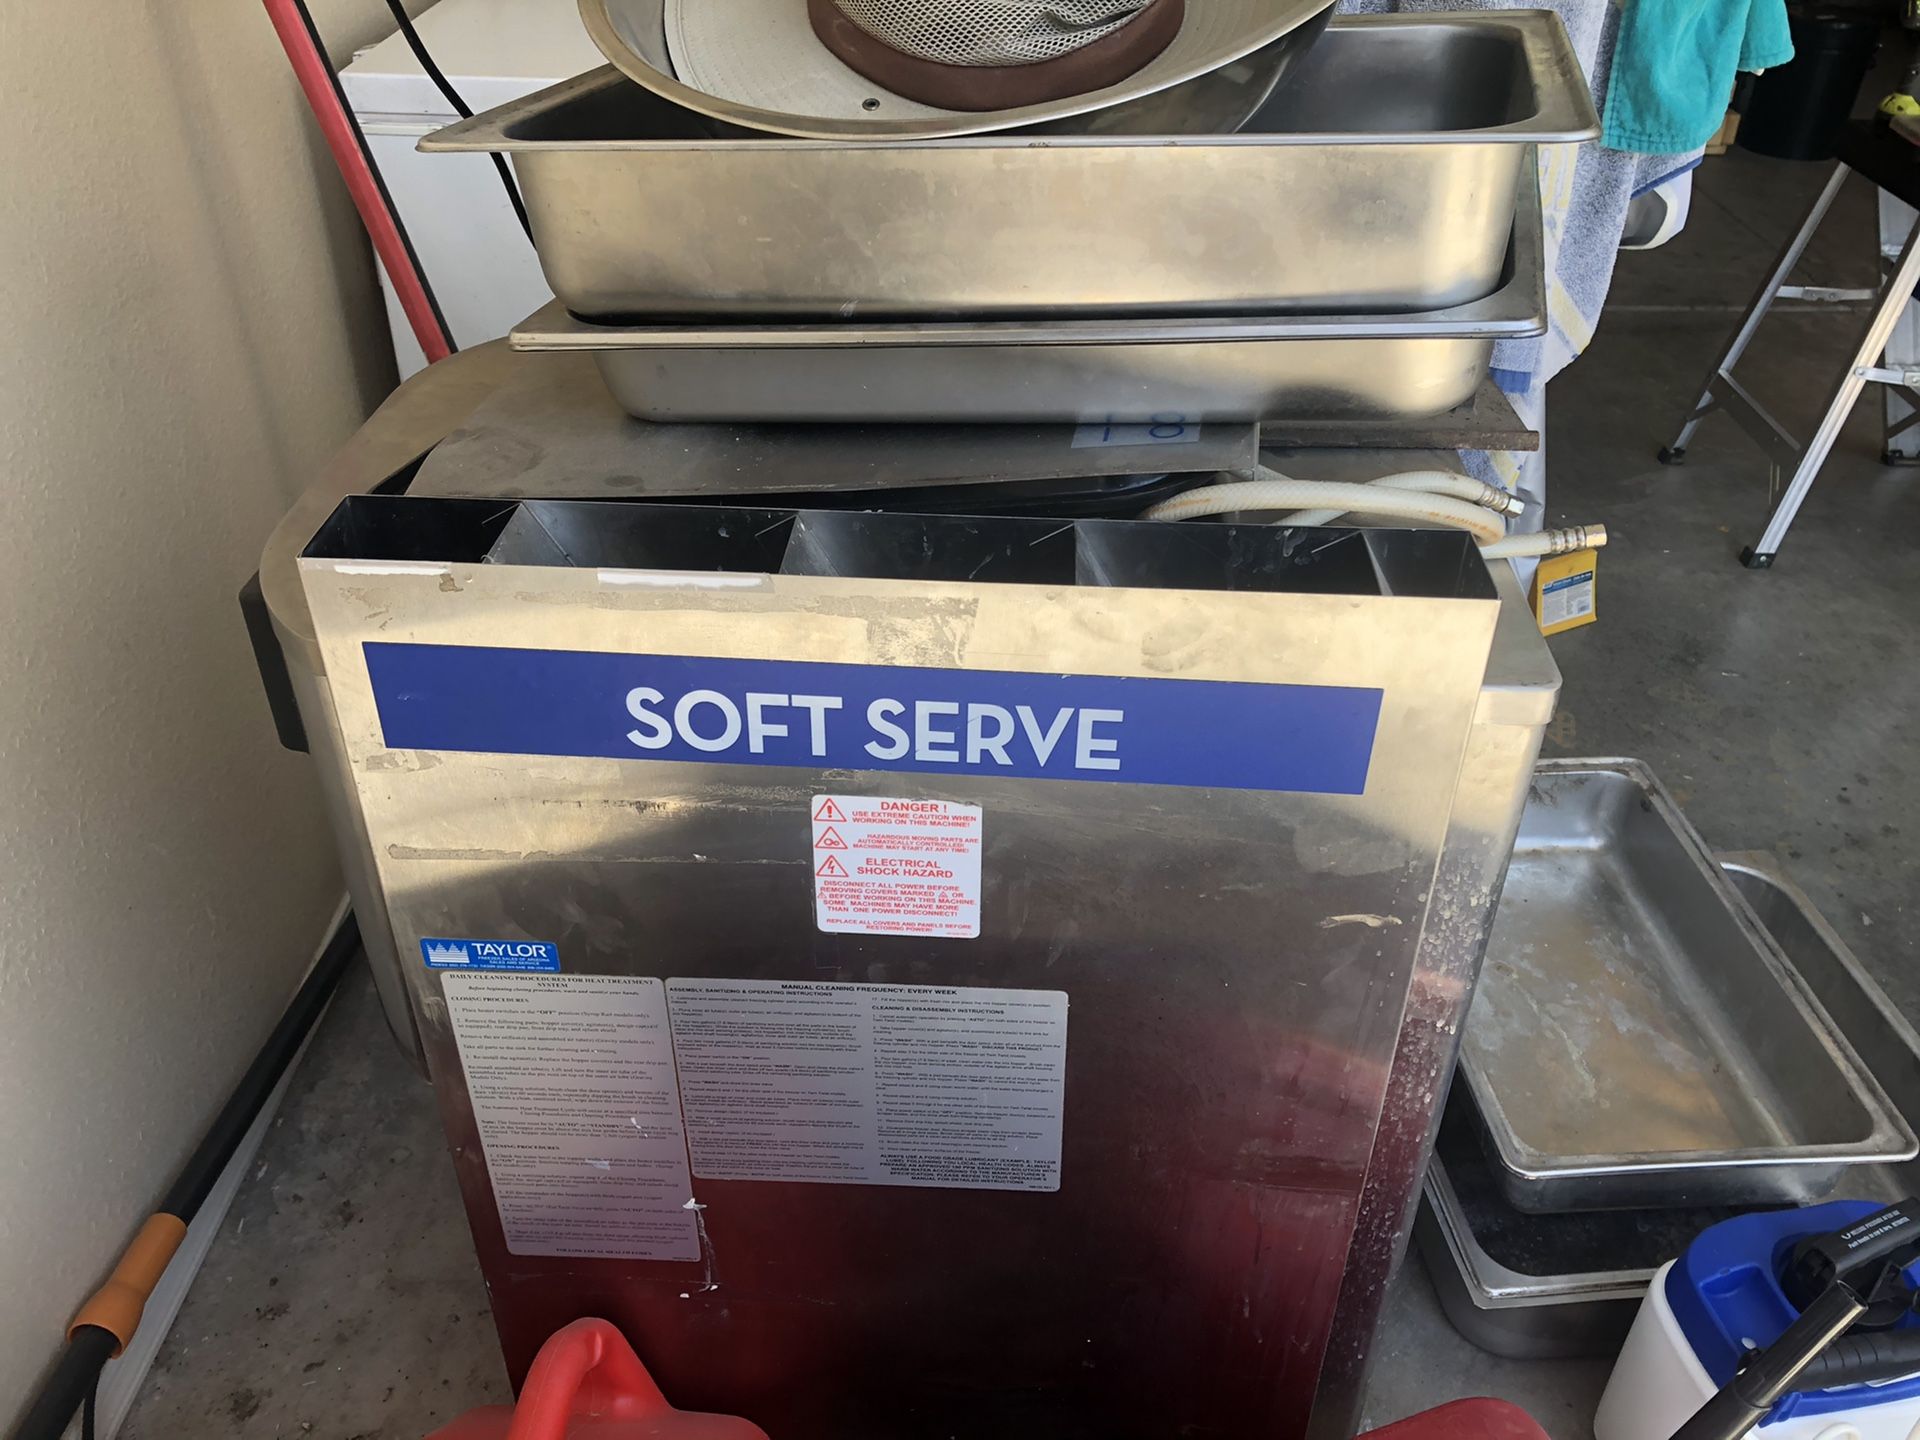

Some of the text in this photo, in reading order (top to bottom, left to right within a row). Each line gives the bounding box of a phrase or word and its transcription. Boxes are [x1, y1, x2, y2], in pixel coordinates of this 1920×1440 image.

[626, 687, 1124, 770] SOFT SERVE
[880, 802, 939, 813] DANGER
[866, 858, 941, 868] ELECTRICAL
[856, 867, 953, 878] SHOCK HAZARD
[472, 942, 548, 957] TAYLOR
